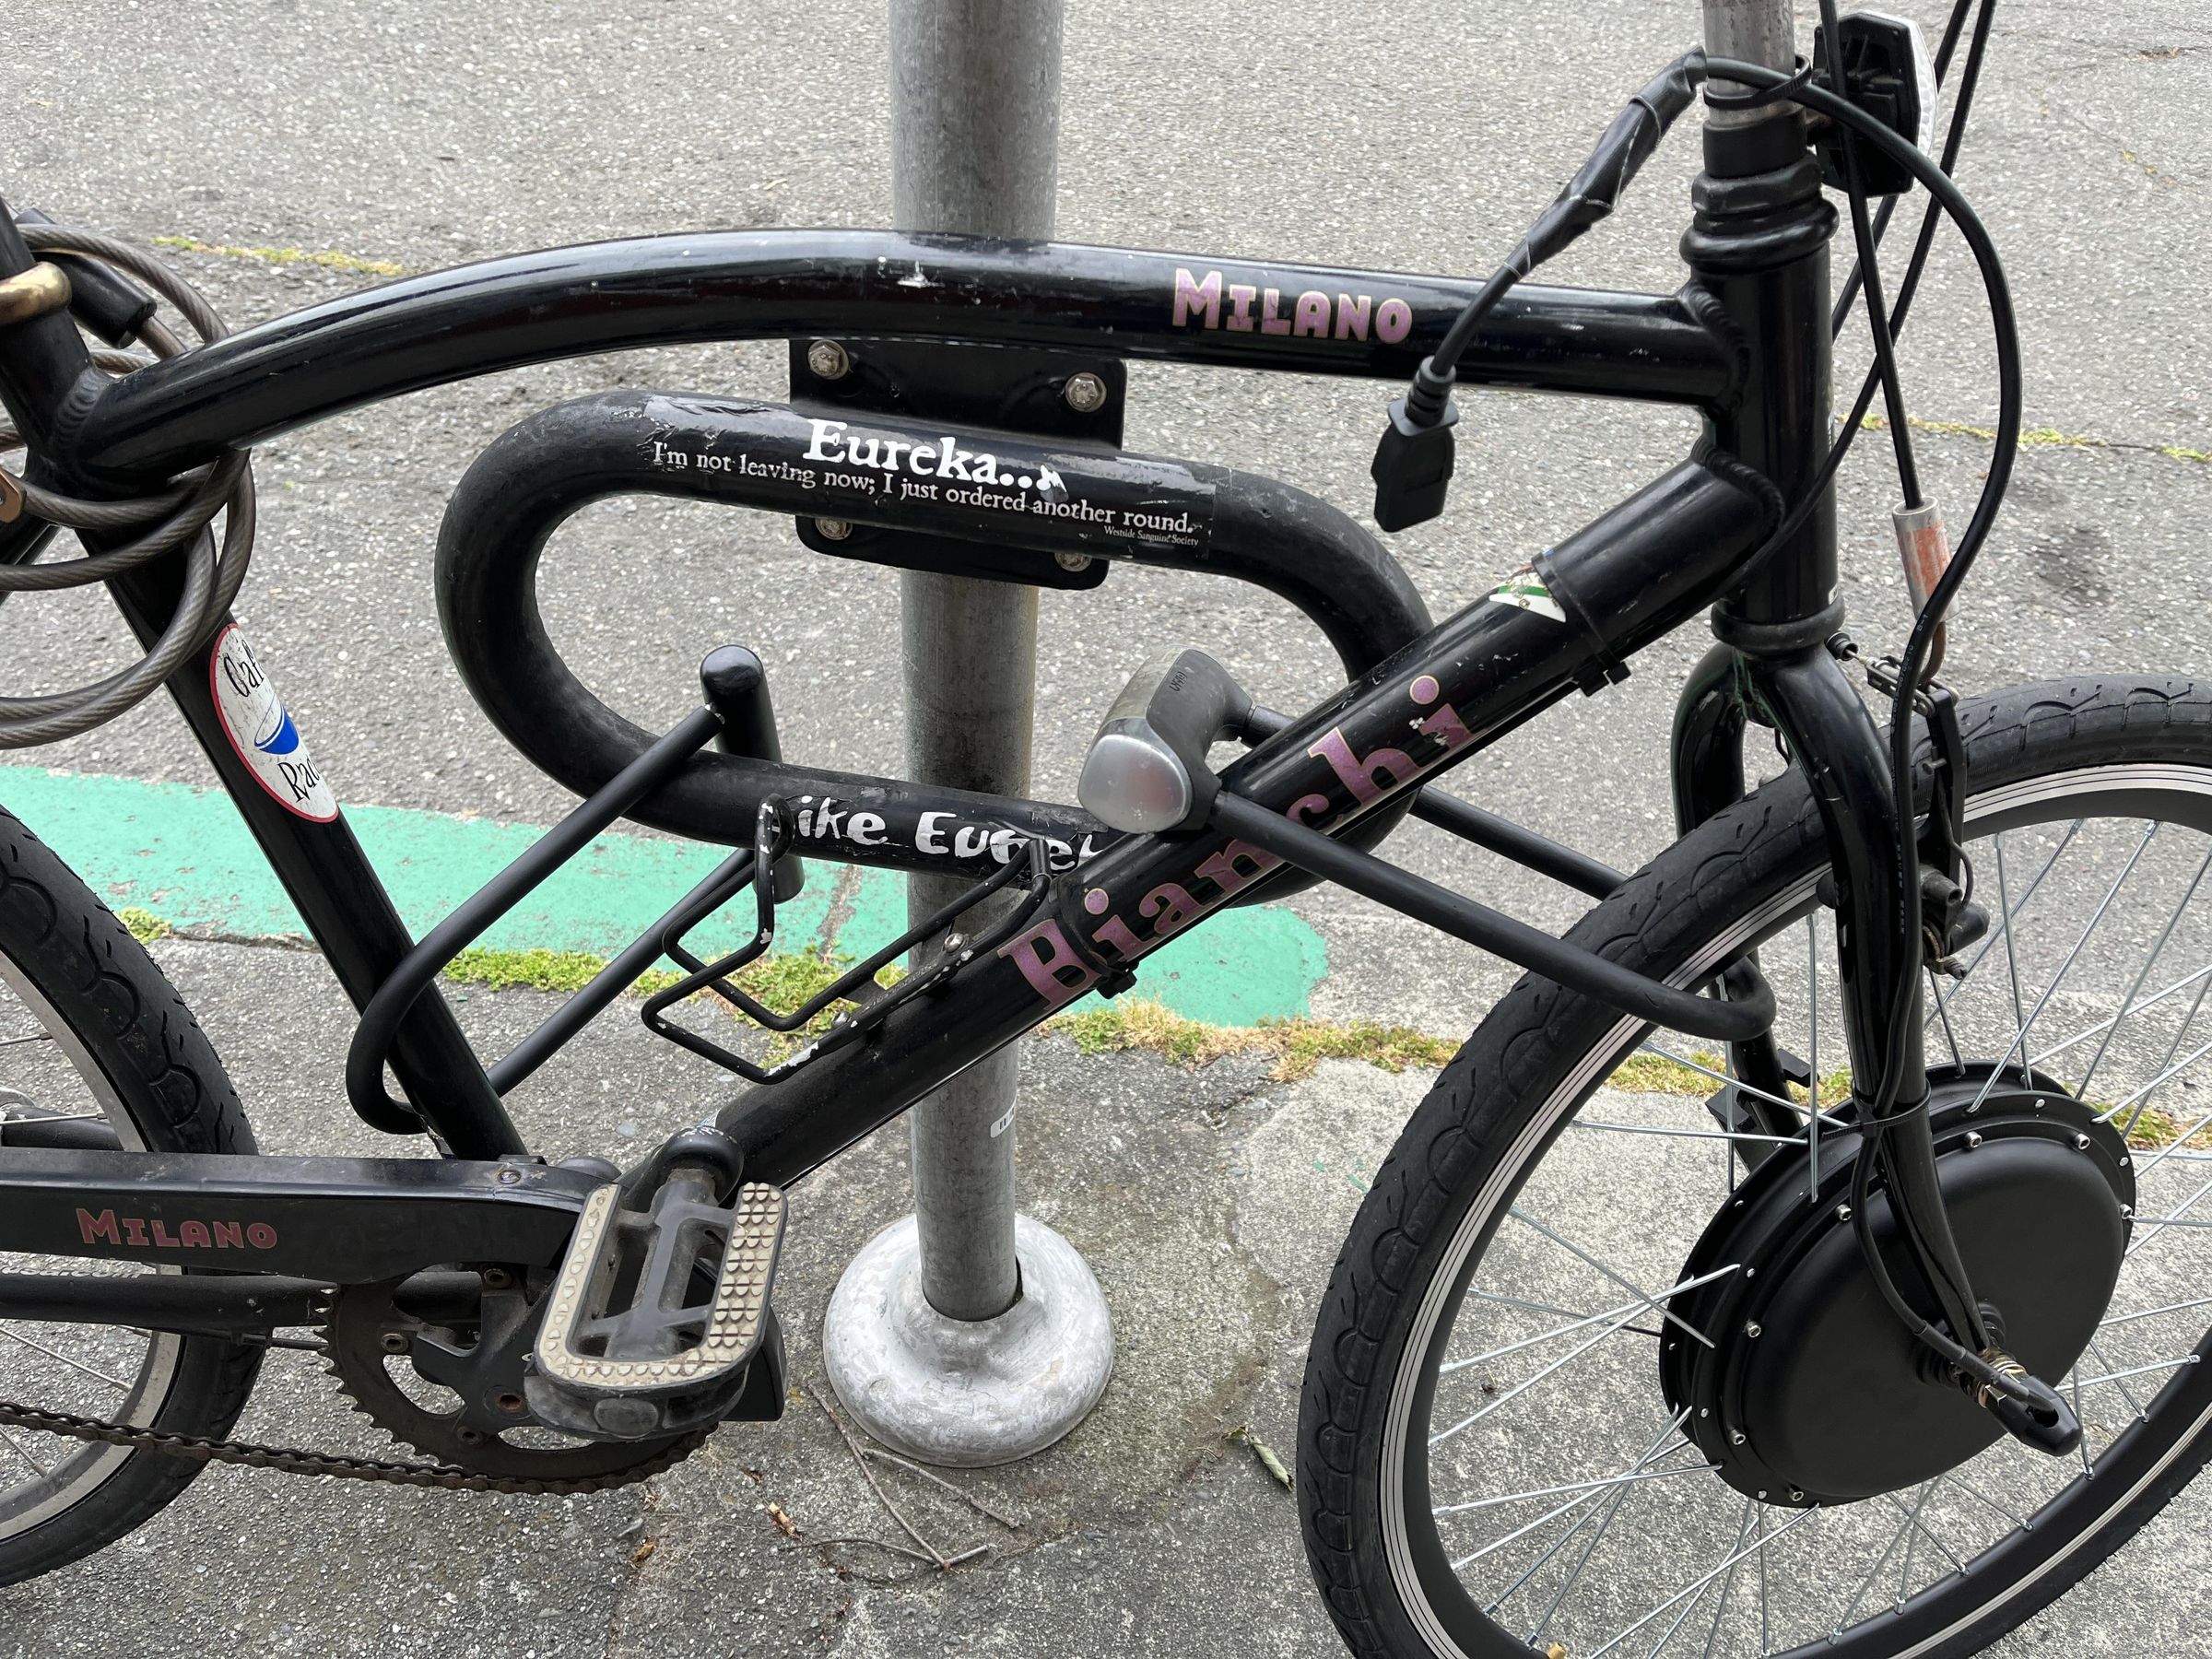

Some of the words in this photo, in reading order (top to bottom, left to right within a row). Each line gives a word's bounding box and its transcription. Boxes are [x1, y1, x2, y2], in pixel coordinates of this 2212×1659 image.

[1171, 267, 1414, 345] MILANO
[653, 441, 679, 466] I'm
[696, 453, 732, 472] not
[738, 453, 817, 489] leaving
[824, 471, 876, 496] now;
[882, 472, 894, 494] I
[900, 477, 939, 501] just
[945, 486, 1027, 512] ordered
[1032, 499, 1116, 524] another
[1124, 512, 1194, 534] round.
[1103, 524, 1135, 539] Westside
[1171, 533, 1199, 547] Society
[223, 639, 265, 698] Caf
[277, 758, 321, 803] Rac
[772, 794, 888, 845] ike
[76, 1207, 278, 1250] MILANO
